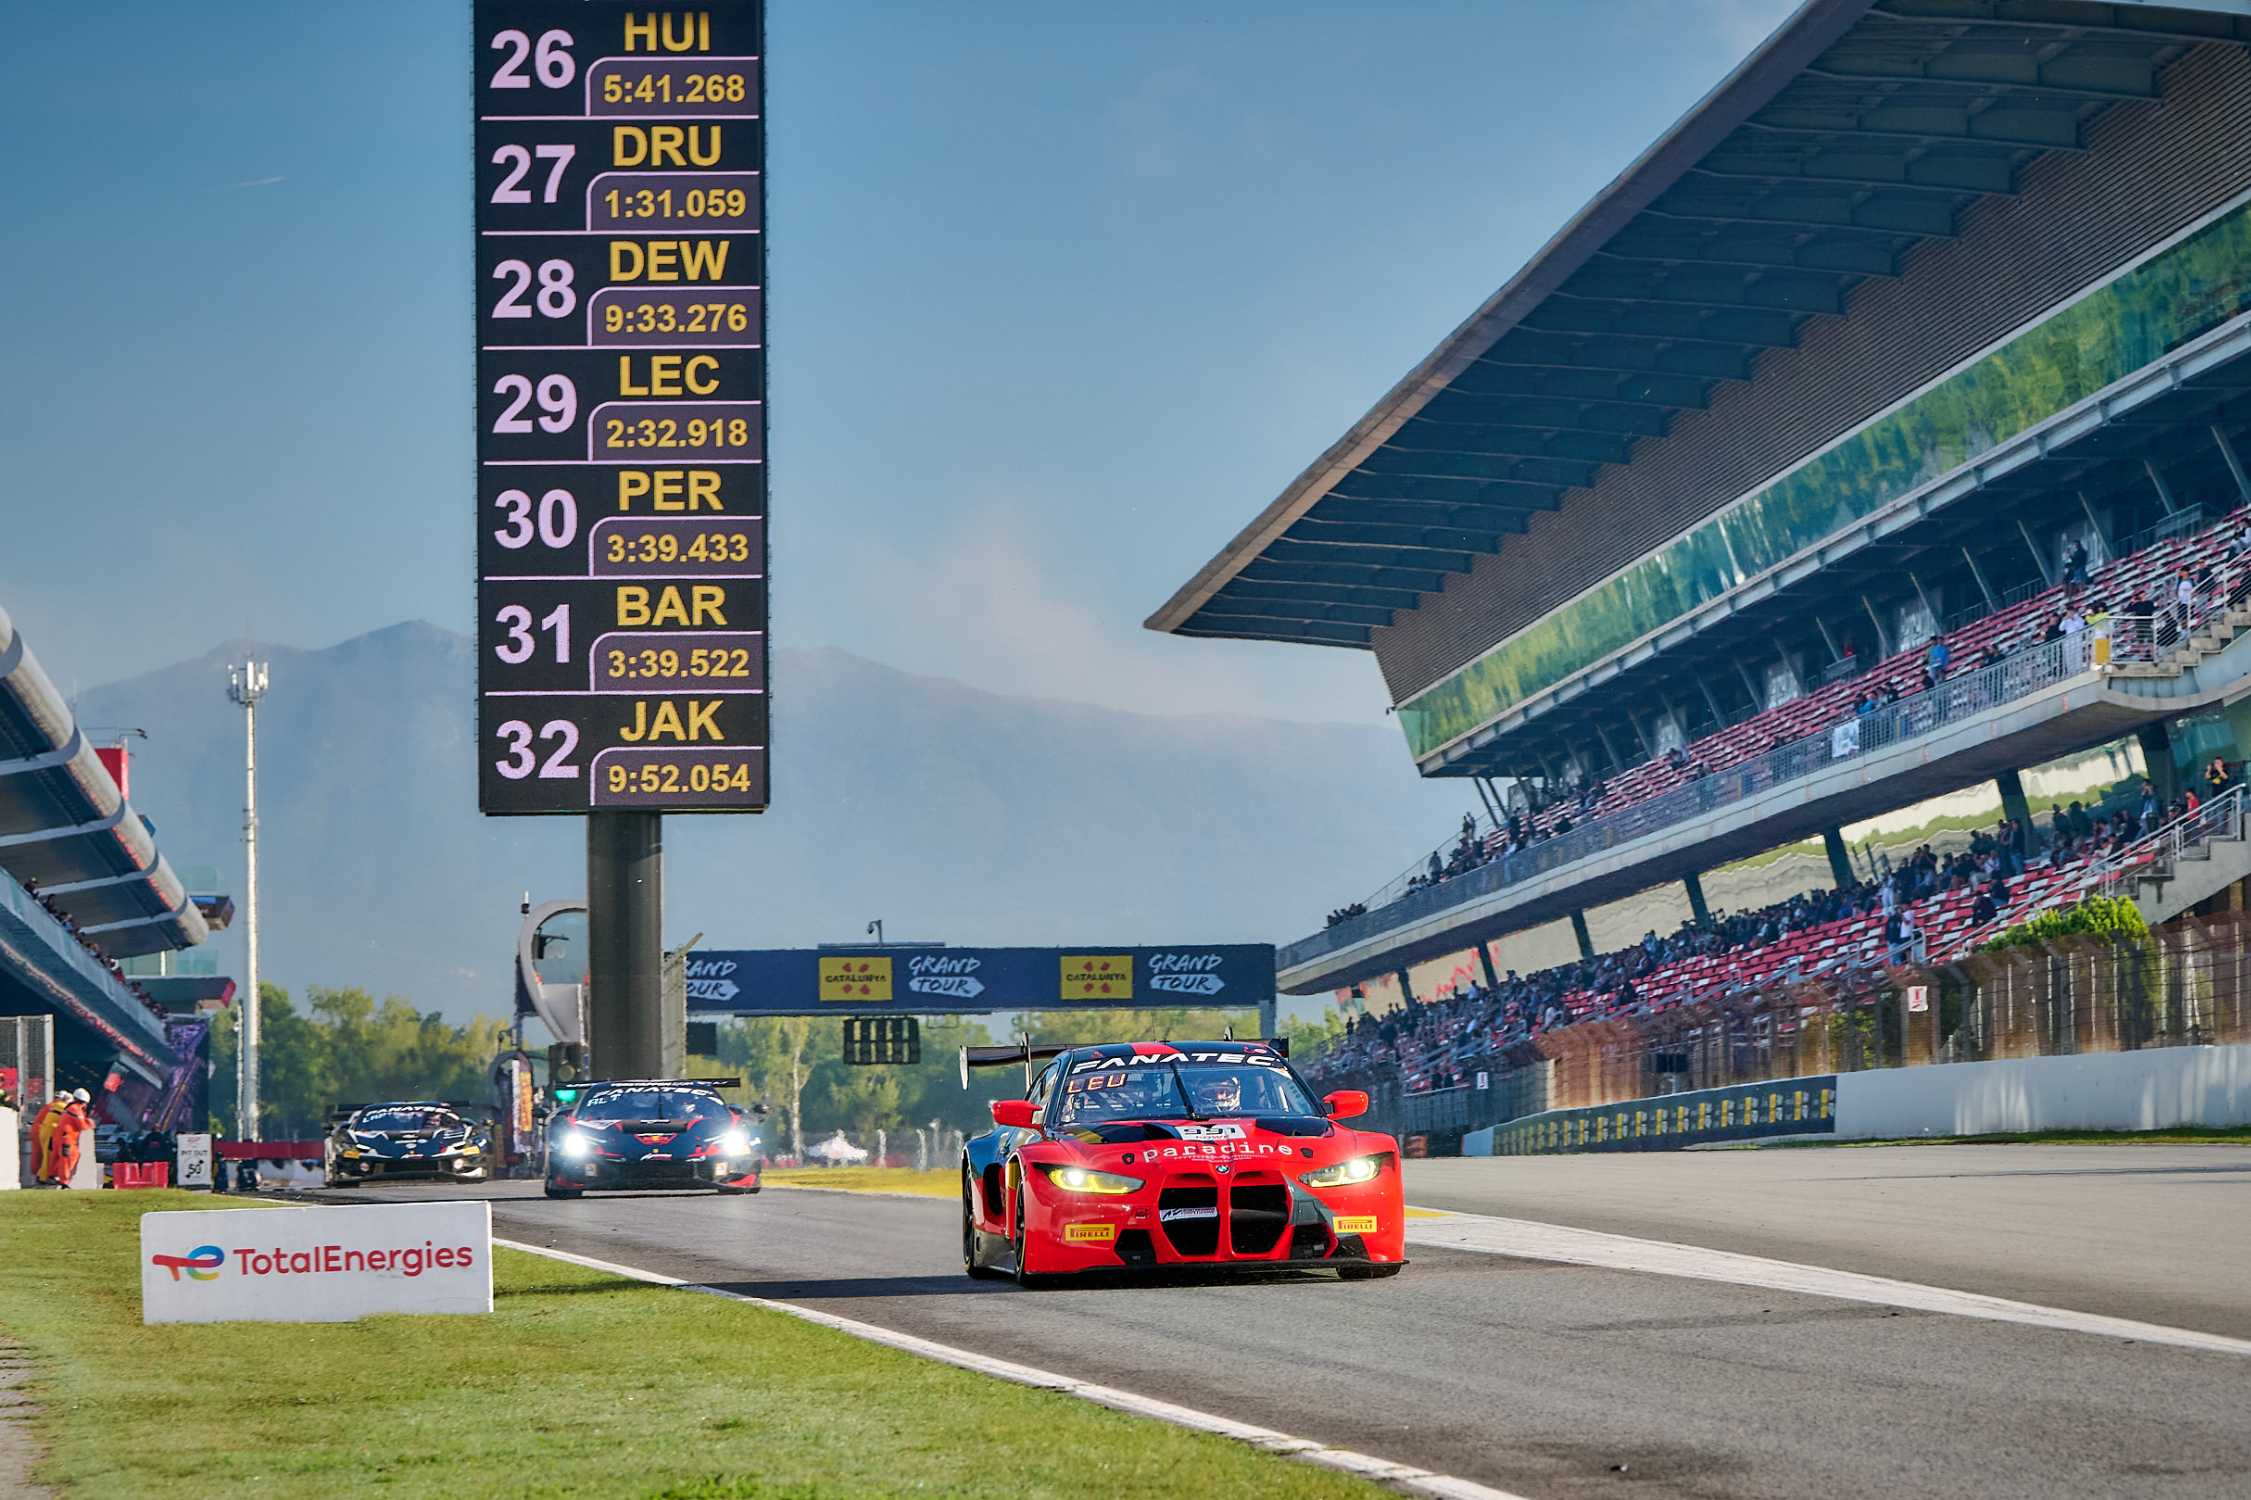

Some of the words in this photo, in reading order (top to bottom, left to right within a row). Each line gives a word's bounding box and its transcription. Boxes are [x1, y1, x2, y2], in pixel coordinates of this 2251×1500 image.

[624, 12, 711, 52] HUI
[490, 29, 576, 89] 26
[603, 74, 746, 103] 5:41.268
[613, 126, 722, 167] DRU
[491, 144, 576, 204] 27
[605, 189, 747, 218] 1:31.059
[610, 241, 730, 282] DEW
[492, 259, 577, 319] 28
[605, 304, 748, 333] 9:33.276
[619, 355, 721, 396] LEC
[493, 374, 578, 434] 29
[606, 418, 748, 448] 2:32.918
[618, 470, 725, 511] PER
[494, 489, 578, 549] 30
[607, 534, 750, 563] 3:39.433
[616, 585, 728, 626] BAR
[495, 604, 571, 664] 31
[608, 649, 751, 678] 3:39.522
[619, 700, 725, 741] JAK
[495, 719, 580, 780] 32
[608, 763, 752, 793] 9:52.054
[687, 960, 738, 976] AND
[825, 973, 887, 983] CATALUNYA
[908, 956, 981, 975] GRAND
[1149, 954, 1223, 974] GRAND
[687, 981, 728, 998] OUR
[916, 977, 970, 995] TOUR
[1158, 975, 1212, 992] TOUR
[1071, 1051, 1276, 1075] FANATEC
[1066, 1073, 1127, 1095] LEU
[1142, 1142, 1294, 1163] paradine
[233, 1240, 474, 1278] TotalEnergies
